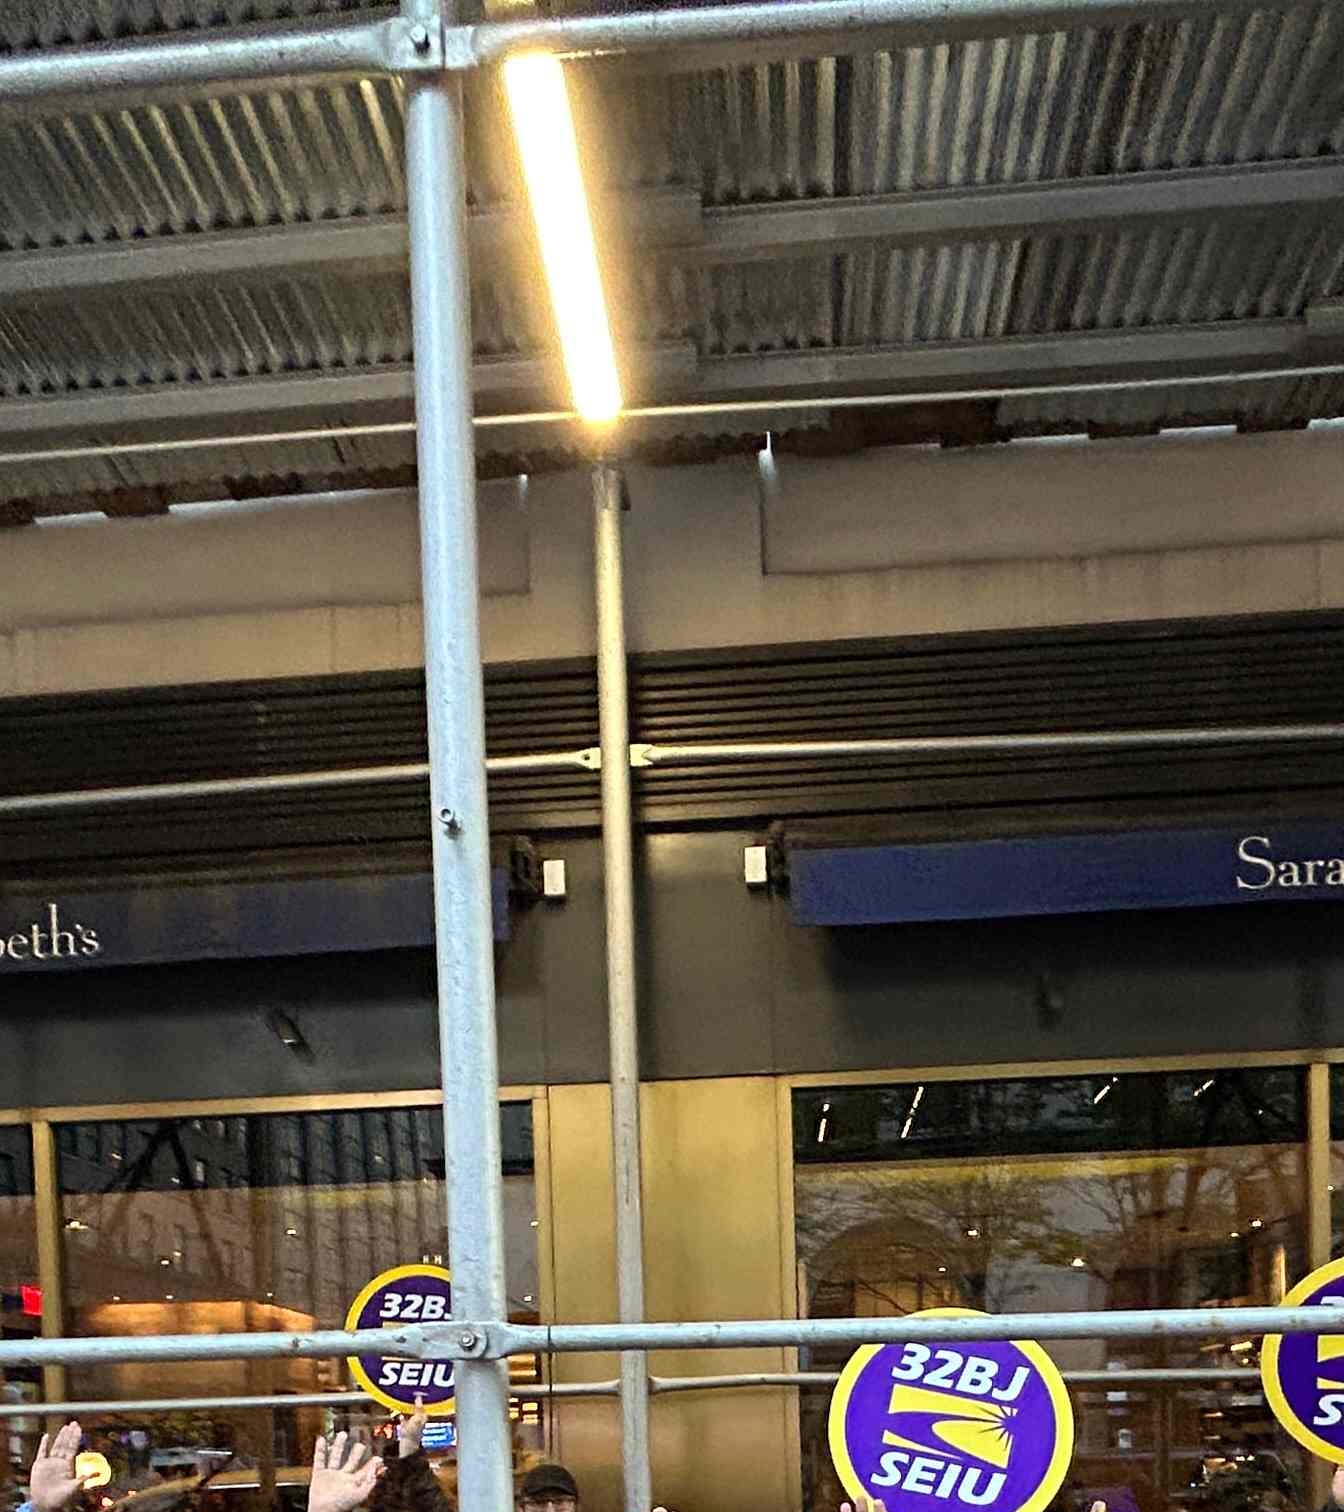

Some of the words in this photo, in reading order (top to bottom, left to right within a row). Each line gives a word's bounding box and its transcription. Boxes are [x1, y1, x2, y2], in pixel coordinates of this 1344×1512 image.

[379, 1293, 454, 1320] 32B
[378, 1362, 455, 1387] SEIU
[891, 1342, 1030, 1401] 32BJ
[870, 1451, 1008, 1506] SEIU
